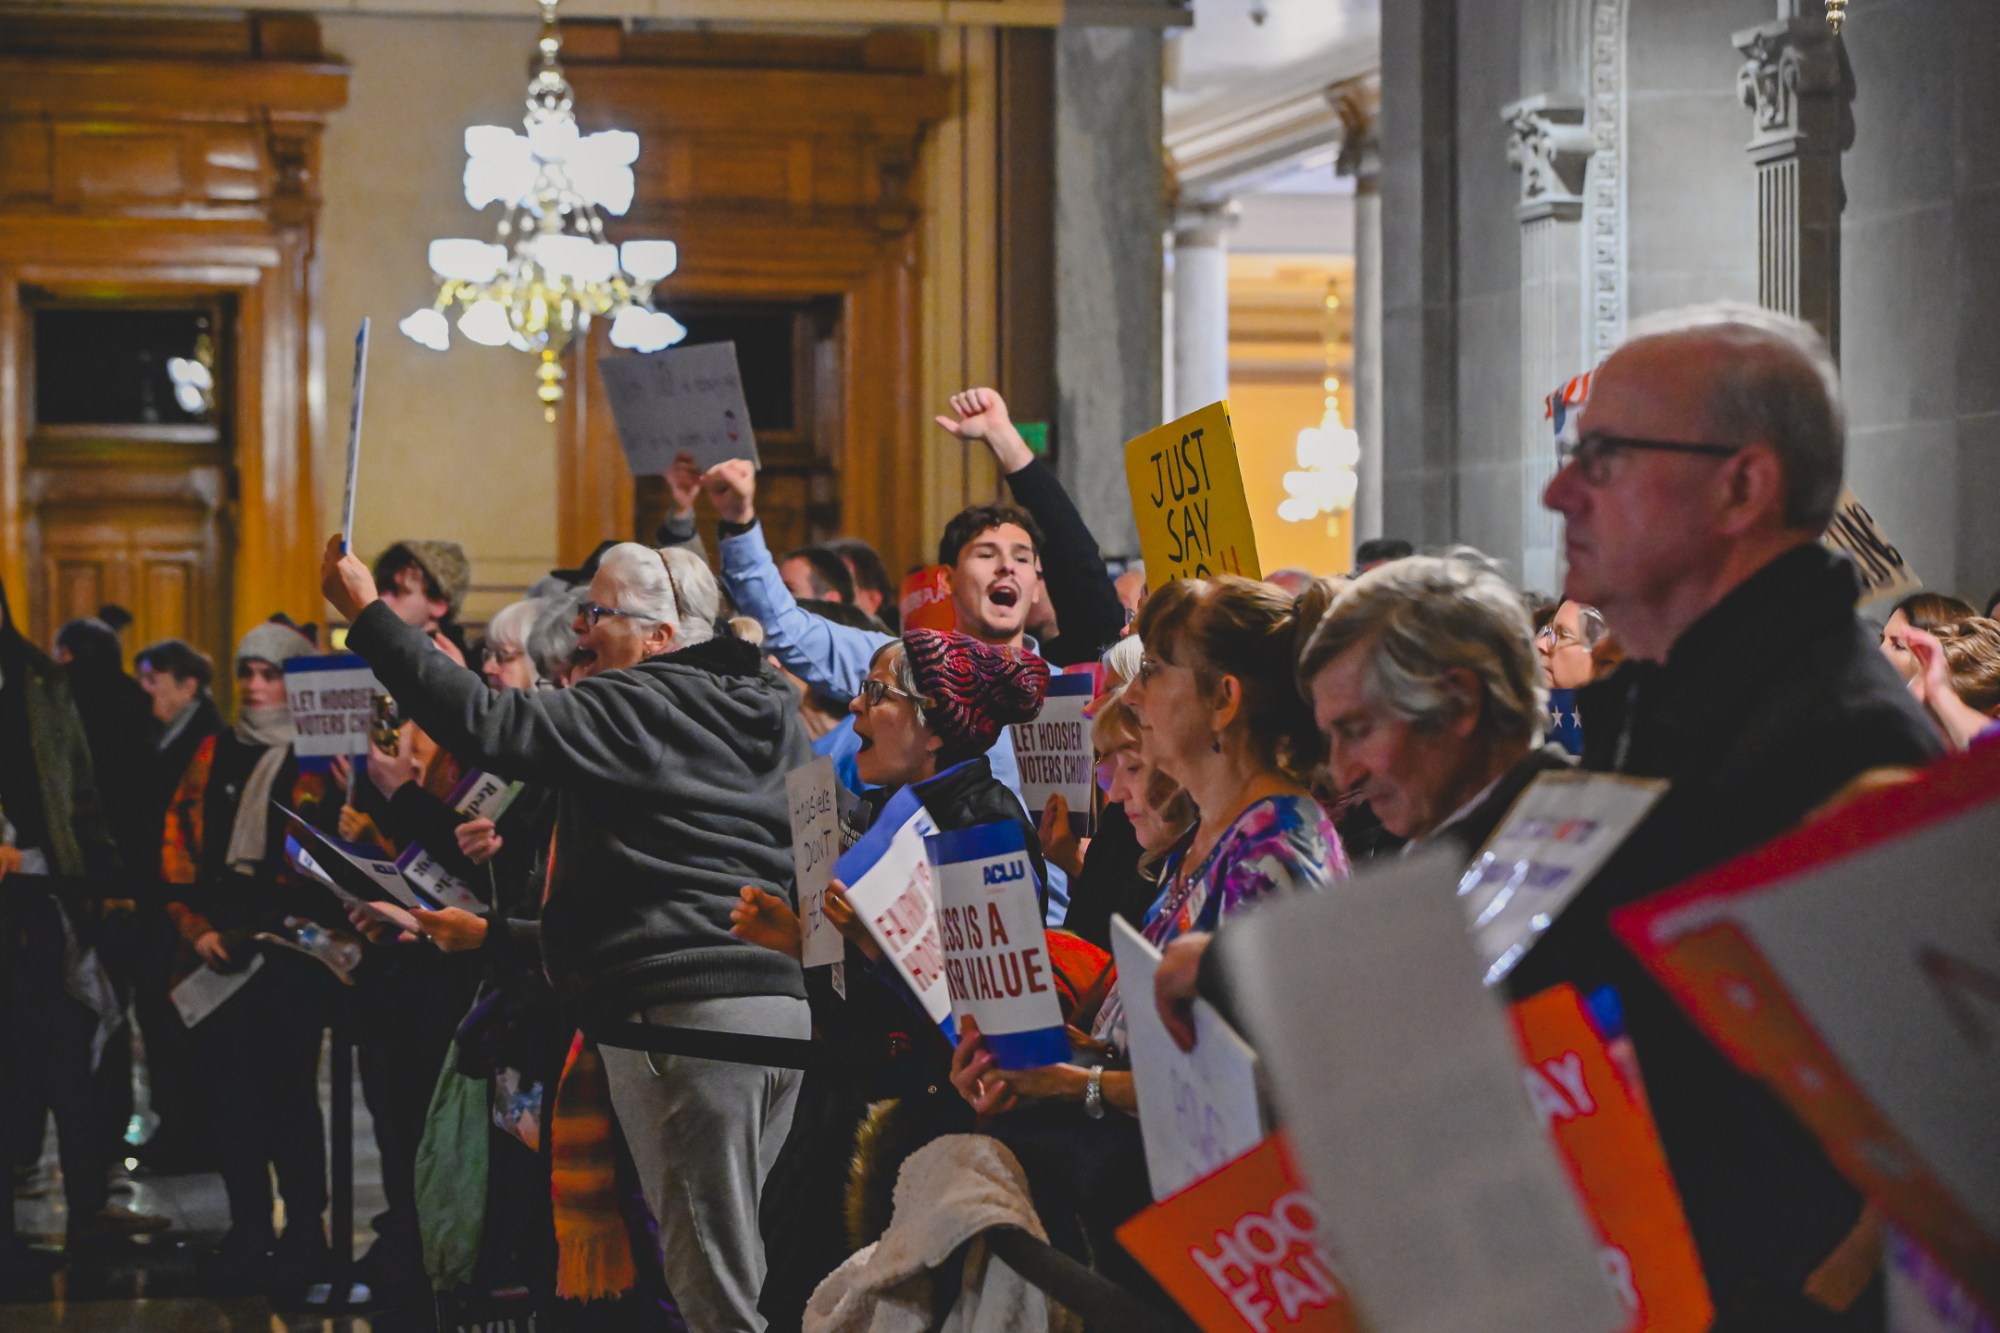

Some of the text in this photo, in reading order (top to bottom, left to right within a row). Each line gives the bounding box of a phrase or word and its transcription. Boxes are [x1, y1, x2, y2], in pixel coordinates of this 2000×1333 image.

[1150, 428, 1211, 508] JUST
[1167, 498, 1212, 563] SAY
[296, 713, 346, 735] VOTERS
[1012, 721, 1083, 753] LET HOOSIER
[1018, 755, 1063, 784] VOTERS
[983, 859, 1025, 886] ACLU
[962, 904, 984, 950] IS
[987, 902, 1009, 947] A
[965, 947, 1048, 1001] VALUE
